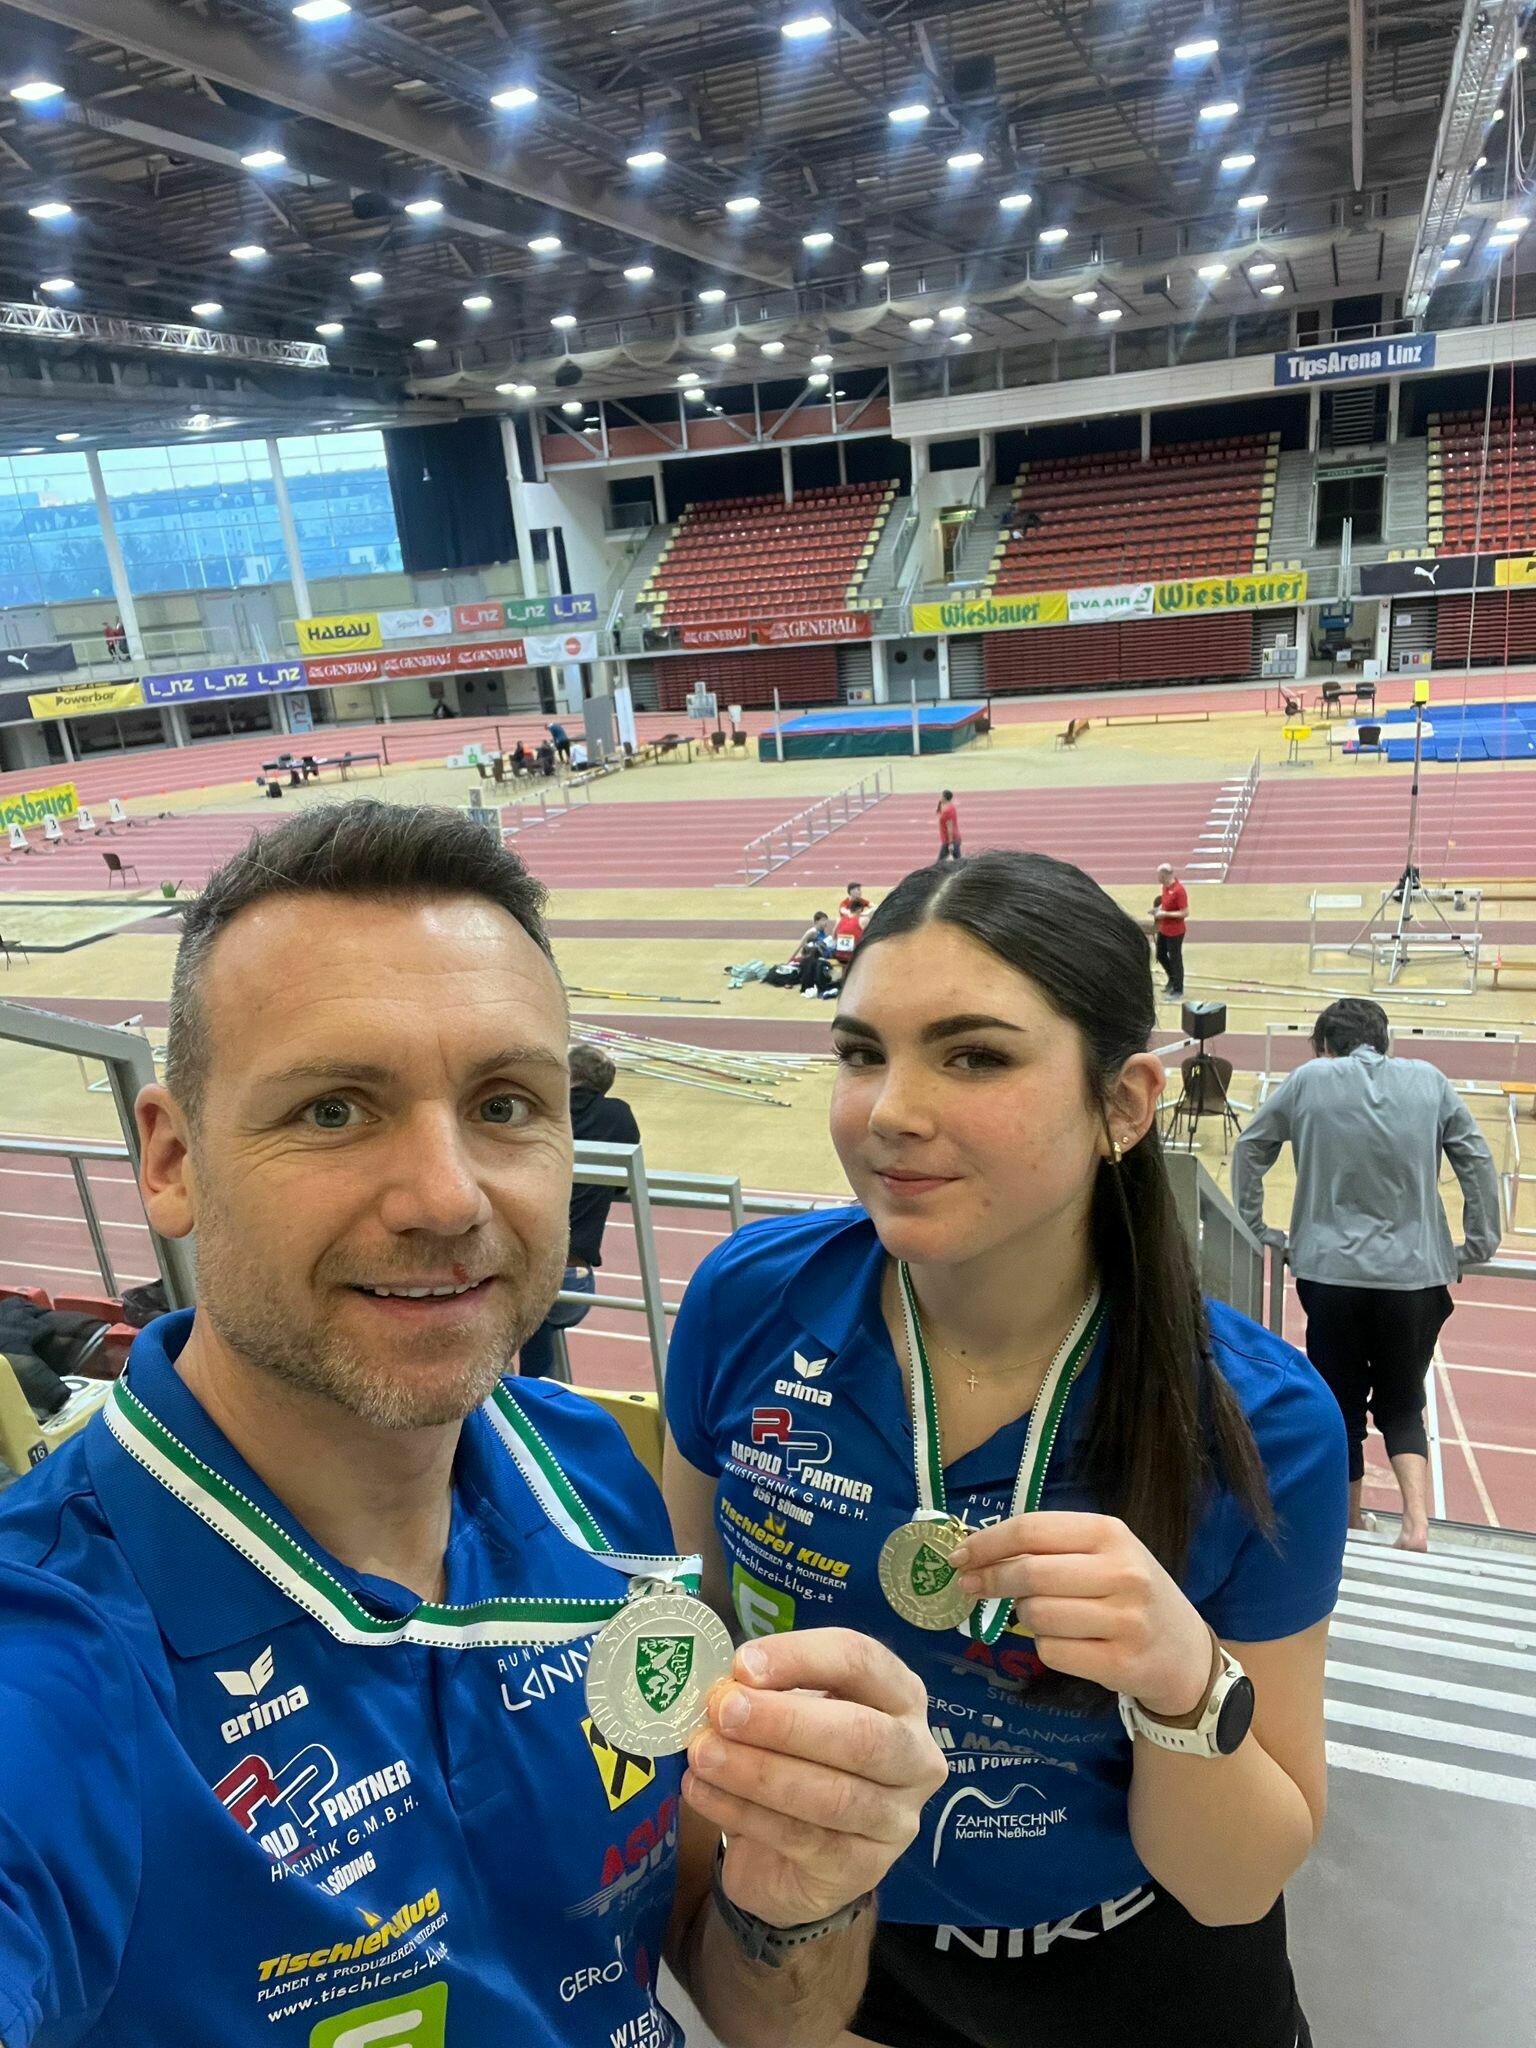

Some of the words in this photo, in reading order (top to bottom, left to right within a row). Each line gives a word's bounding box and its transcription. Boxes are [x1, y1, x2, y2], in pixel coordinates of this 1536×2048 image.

[1288, 351, 1381, 380] TipsArena
[1387, 344, 1422, 366] Linz
[1160, 580, 1302, 610] Wiesbauer
[789, 617, 857, 637] GENERALI
[941, 600, 1040, 627] Wiesbauer
[308, 622, 370, 641] HABAU
[698, 628, 747, 642] GENERALI
[0, 792, 73, 829] iesbauer
[83, 811, 90, 821] 2
[115, 803, 120, 813] 1
[14, 828, 21, 838] 4
[50, 820, 56, 830] 3
[774, 1378, 833, 1407] erima
[32, 1445, 46, 1463] 16
[731, 1440, 783, 1475] RAPPOLD
[800, 1466, 874, 1504] PARTNER
[724, 1461, 799, 1499] HAUSTECHNIK
[802, 1491, 870, 1522] G.M.B.H.
[752, 1485, 776, 1508] 8561
[776, 1497, 815, 1527] SÖDING
[720, 1496, 795, 1556] Tischlerei
[796, 1546, 851, 1578] Klug
[220, 1684, 310, 1744] erima
[927, 1695, 978, 1720] EROT
[321, 1759, 412, 1828] PARTNER
[347, 1795, 420, 1846] G.M.B.H.
[956, 1806, 1068, 1829] ZAHNTECHNIK
[955, 1828, 993, 1840] Martin
[997, 1827, 1048, 1839] Neßhold
[328, 1850, 377, 1896] SÖDING
[935, 1886, 1156, 1959] NIKE
[257, 1976, 310, 2003] PLANEN
[314, 1972, 328, 1983] &
[333, 1939, 417, 1979] PRODUZIEREN
